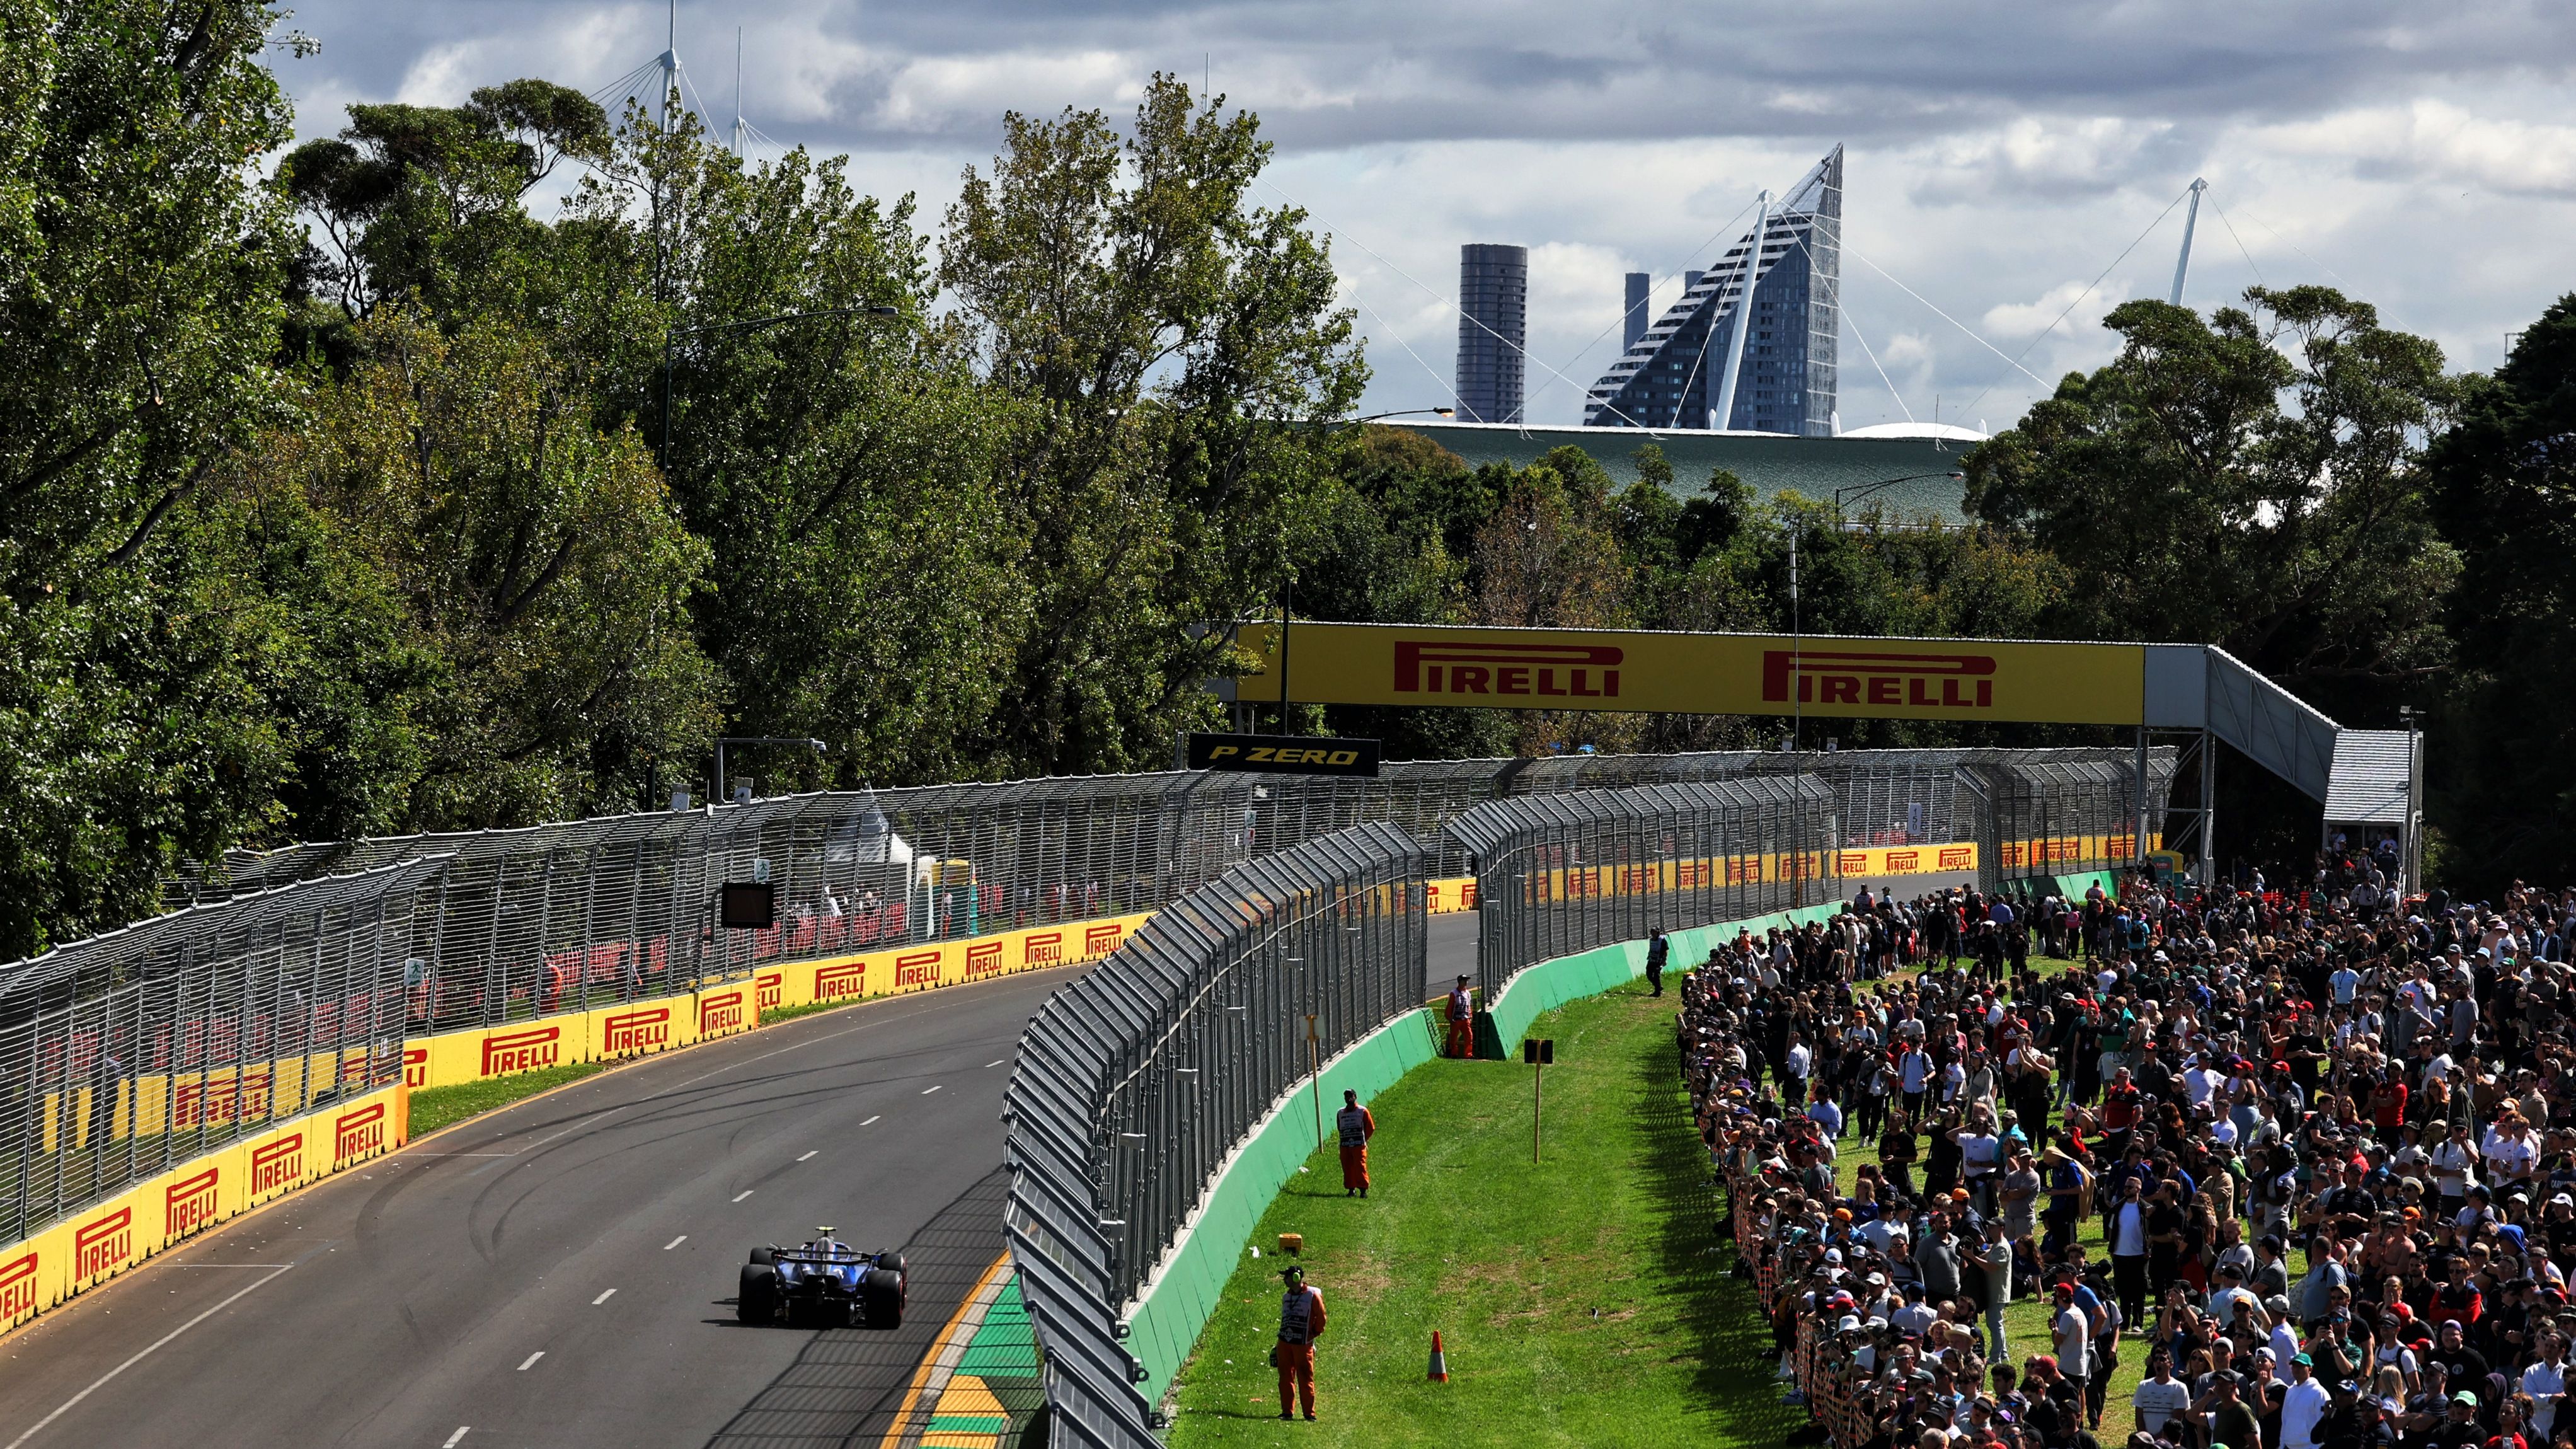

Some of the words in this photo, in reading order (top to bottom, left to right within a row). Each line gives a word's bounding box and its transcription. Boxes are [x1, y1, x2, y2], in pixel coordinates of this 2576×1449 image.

[1394, 640, 1624, 697] PIRELLI
[1762, 650, 1997, 707] PIRELLI
[1209, 746, 1239, 759] P
[1245, 748, 1359, 766] ZERO
[1887, 852, 1918, 871] PIRELLI
[1939, 848, 1971, 868] PIRELLI
[966, 941, 1002, 976] PIRELLI
[1025, 932, 1061, 964] PIRELLI
[1086, 924, 1121, 955] PIRELLI
[815, 962, 865, 999] PIRELLI
[895, 951, 940, 987] PIRELLI
[605, 1008, 669, 1053] PIRELLI
[700, 991, 742, 1034] PIRELLI
[481, 1026, 560, 1076] PIRELLI
[335, 1103, 384, 1161] PIRELLI
[252, 1133, 302, 1195] PIRELLI
[166, 1167, 219, 1235] PIRELLI
[76, 1206, 131, 1282] PIRELLI
